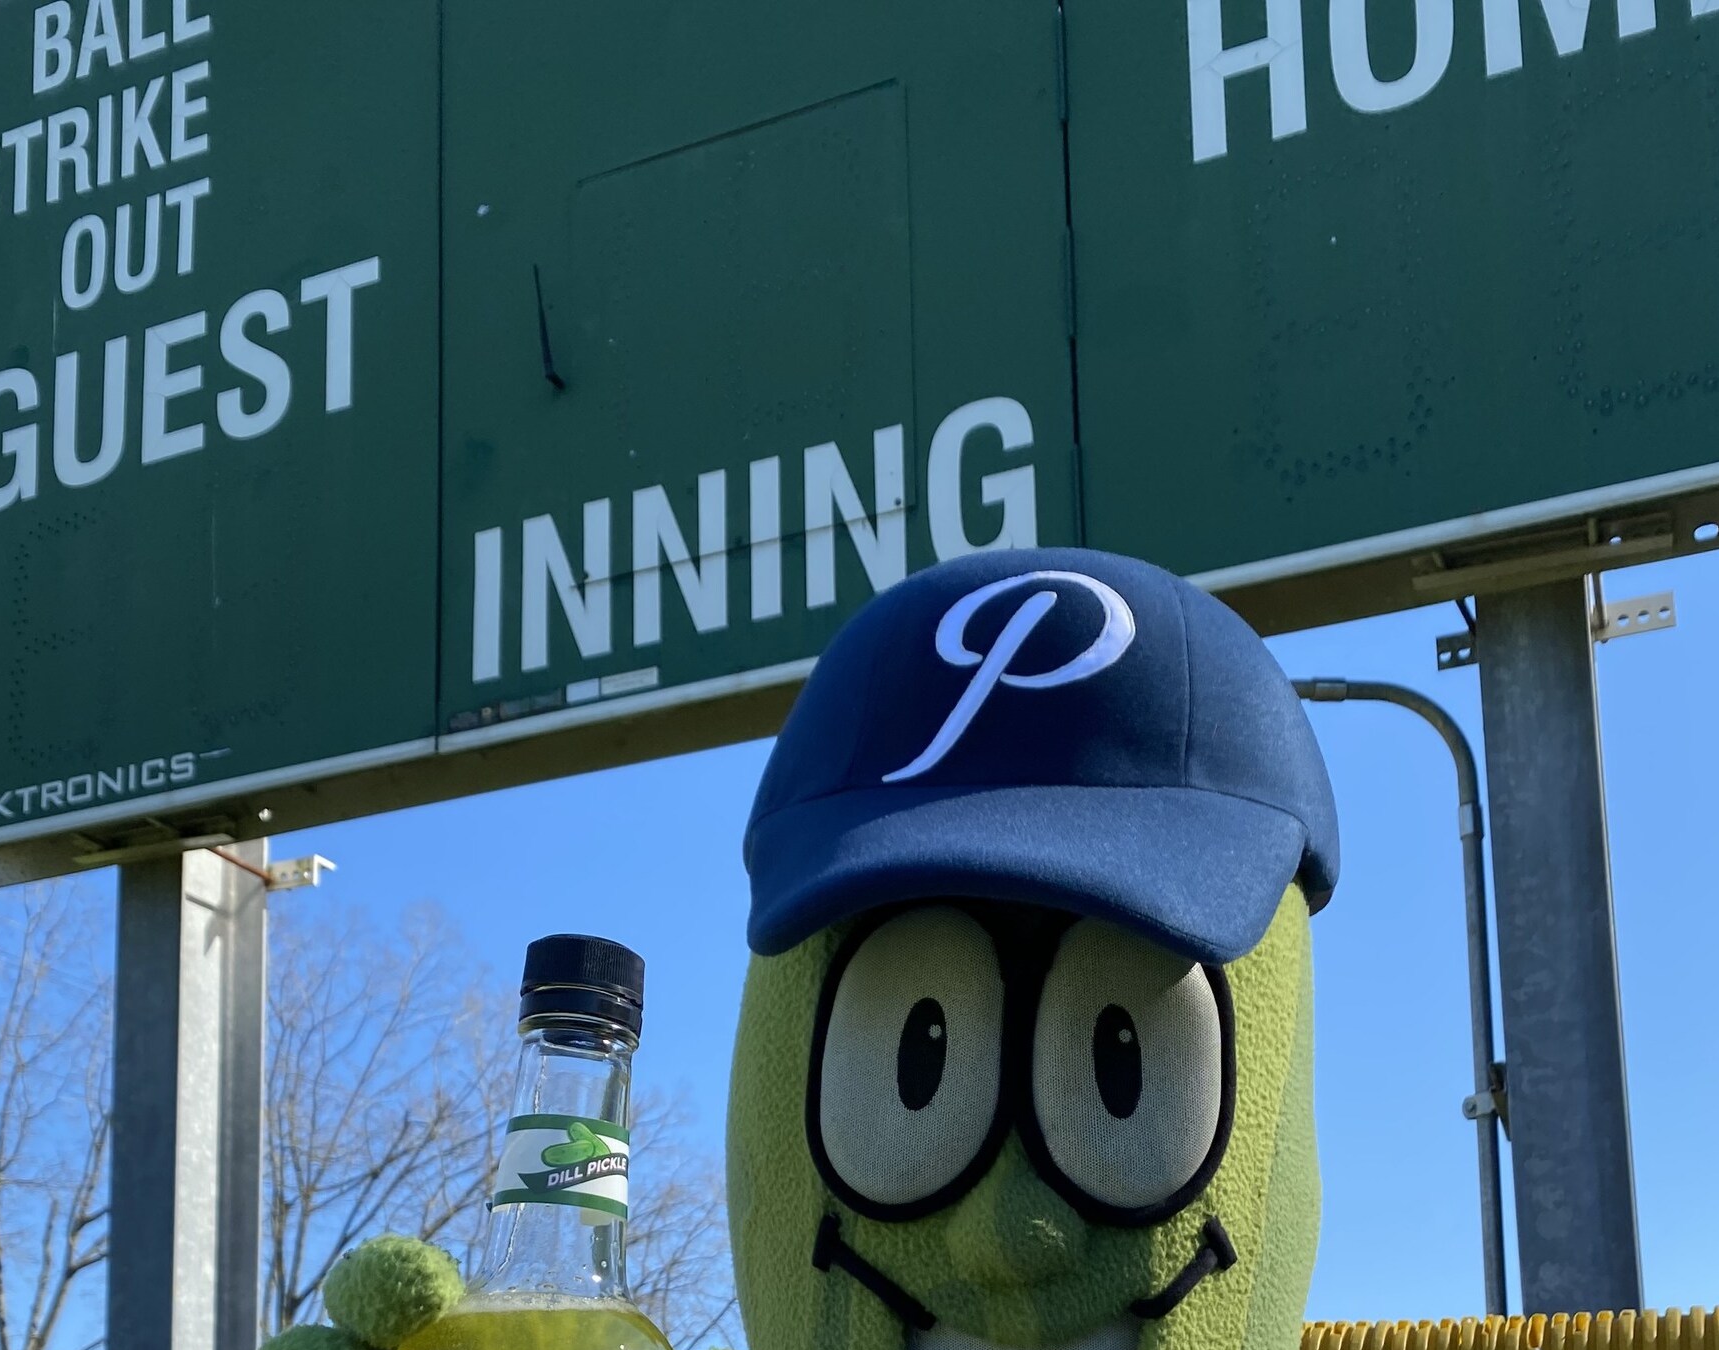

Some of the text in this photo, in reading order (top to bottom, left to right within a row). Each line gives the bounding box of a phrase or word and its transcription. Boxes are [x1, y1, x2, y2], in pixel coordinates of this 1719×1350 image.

[32, 0, 211, 94] BALL
[61, 178, 211, 310] OUT
[473, 396, 1039, 684] INNING
[881, 569, 1136, 784] P
[546, 1156, 627, 1187] DILL PICKLE
